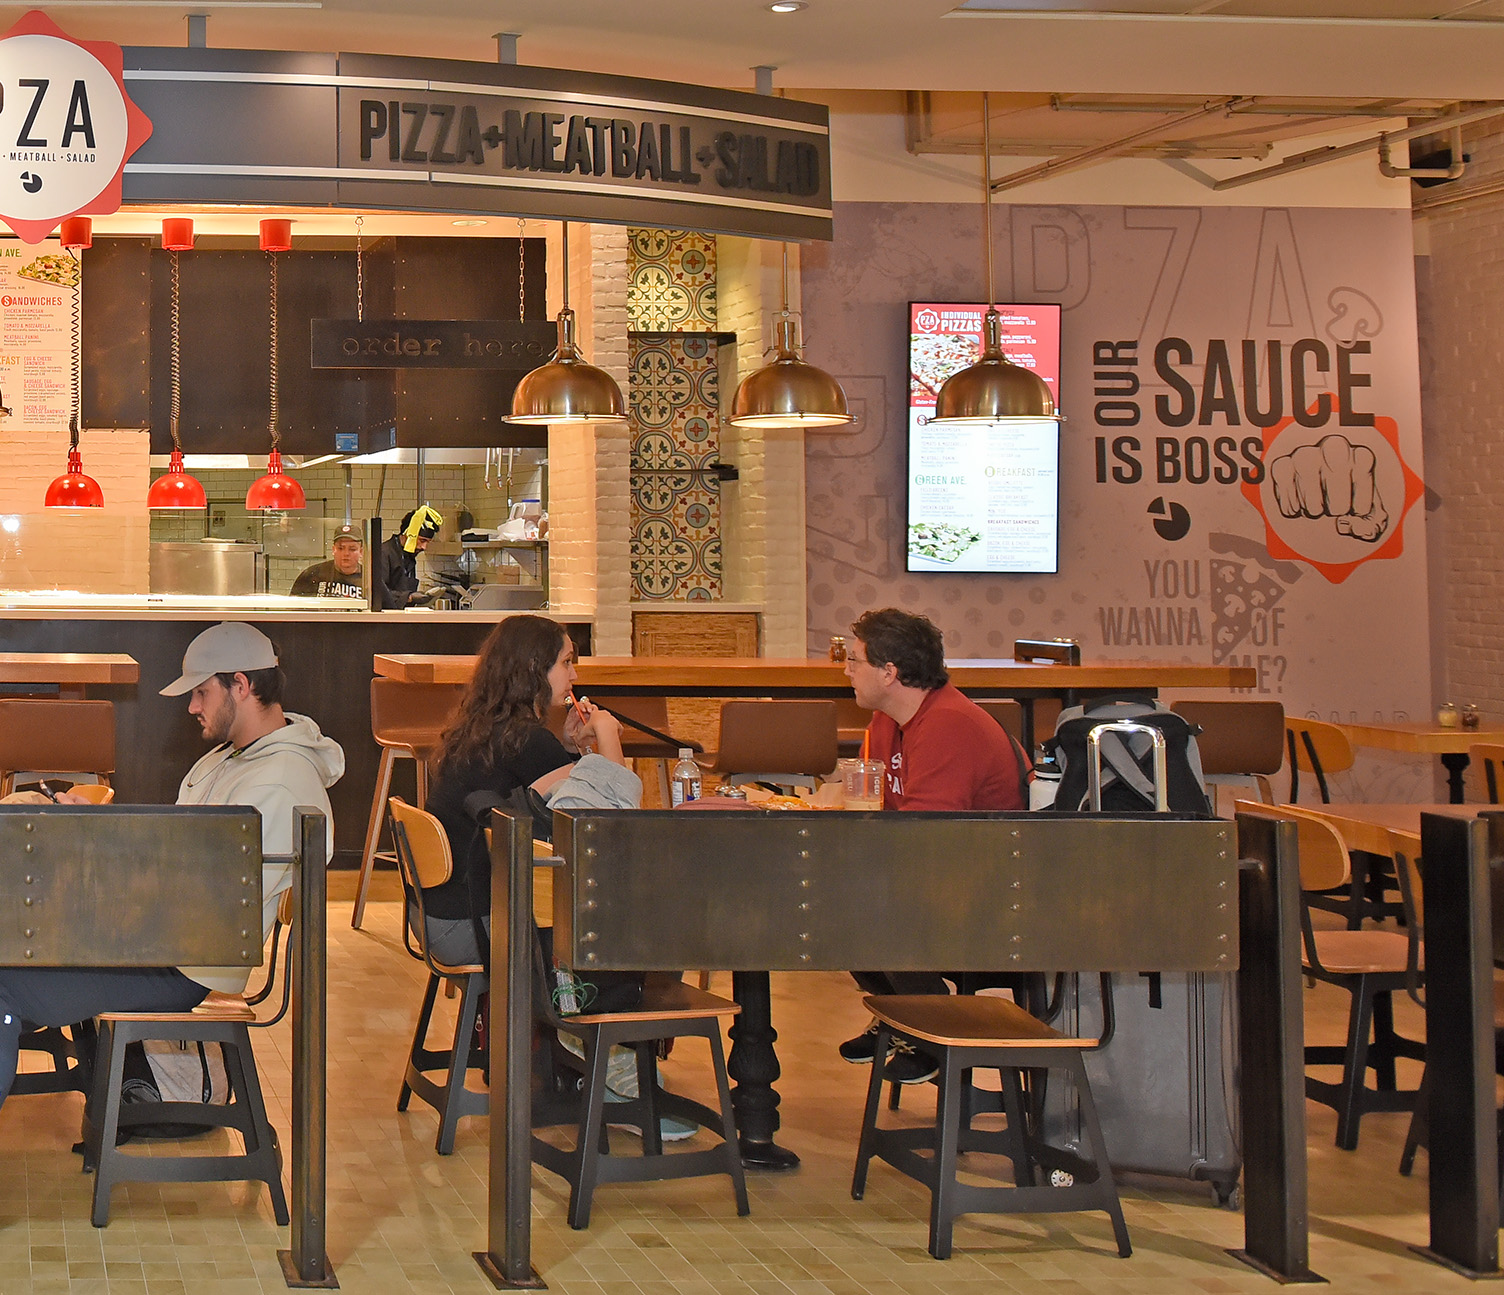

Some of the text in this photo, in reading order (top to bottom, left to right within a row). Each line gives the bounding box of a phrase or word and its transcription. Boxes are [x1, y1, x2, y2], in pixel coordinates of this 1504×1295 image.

[9, 152, 57, 162] MEATBALL
[66, 153, 96, 163] SALAD
[1, 295, 63, 307] SANDWICHES
[920, 315, 935, 326] PZA
[940, 311, 982, 320] INDIVIDUAL
[940, 320, 982, 332] PIZZAS
[342, 333, 442, 356] order
[1094, 340, 1140, 427] OUR
[1153, 338, 1375, 428] SAUCE
[1094, 435, 1142, 485] IS
[1156, 436, 1266, 485] BOSS
[915, 474, 947, 485] GREEN
[1143, 559, 1200, 599] YOU
[1098, 606, 1286, 647] WANNA OF
